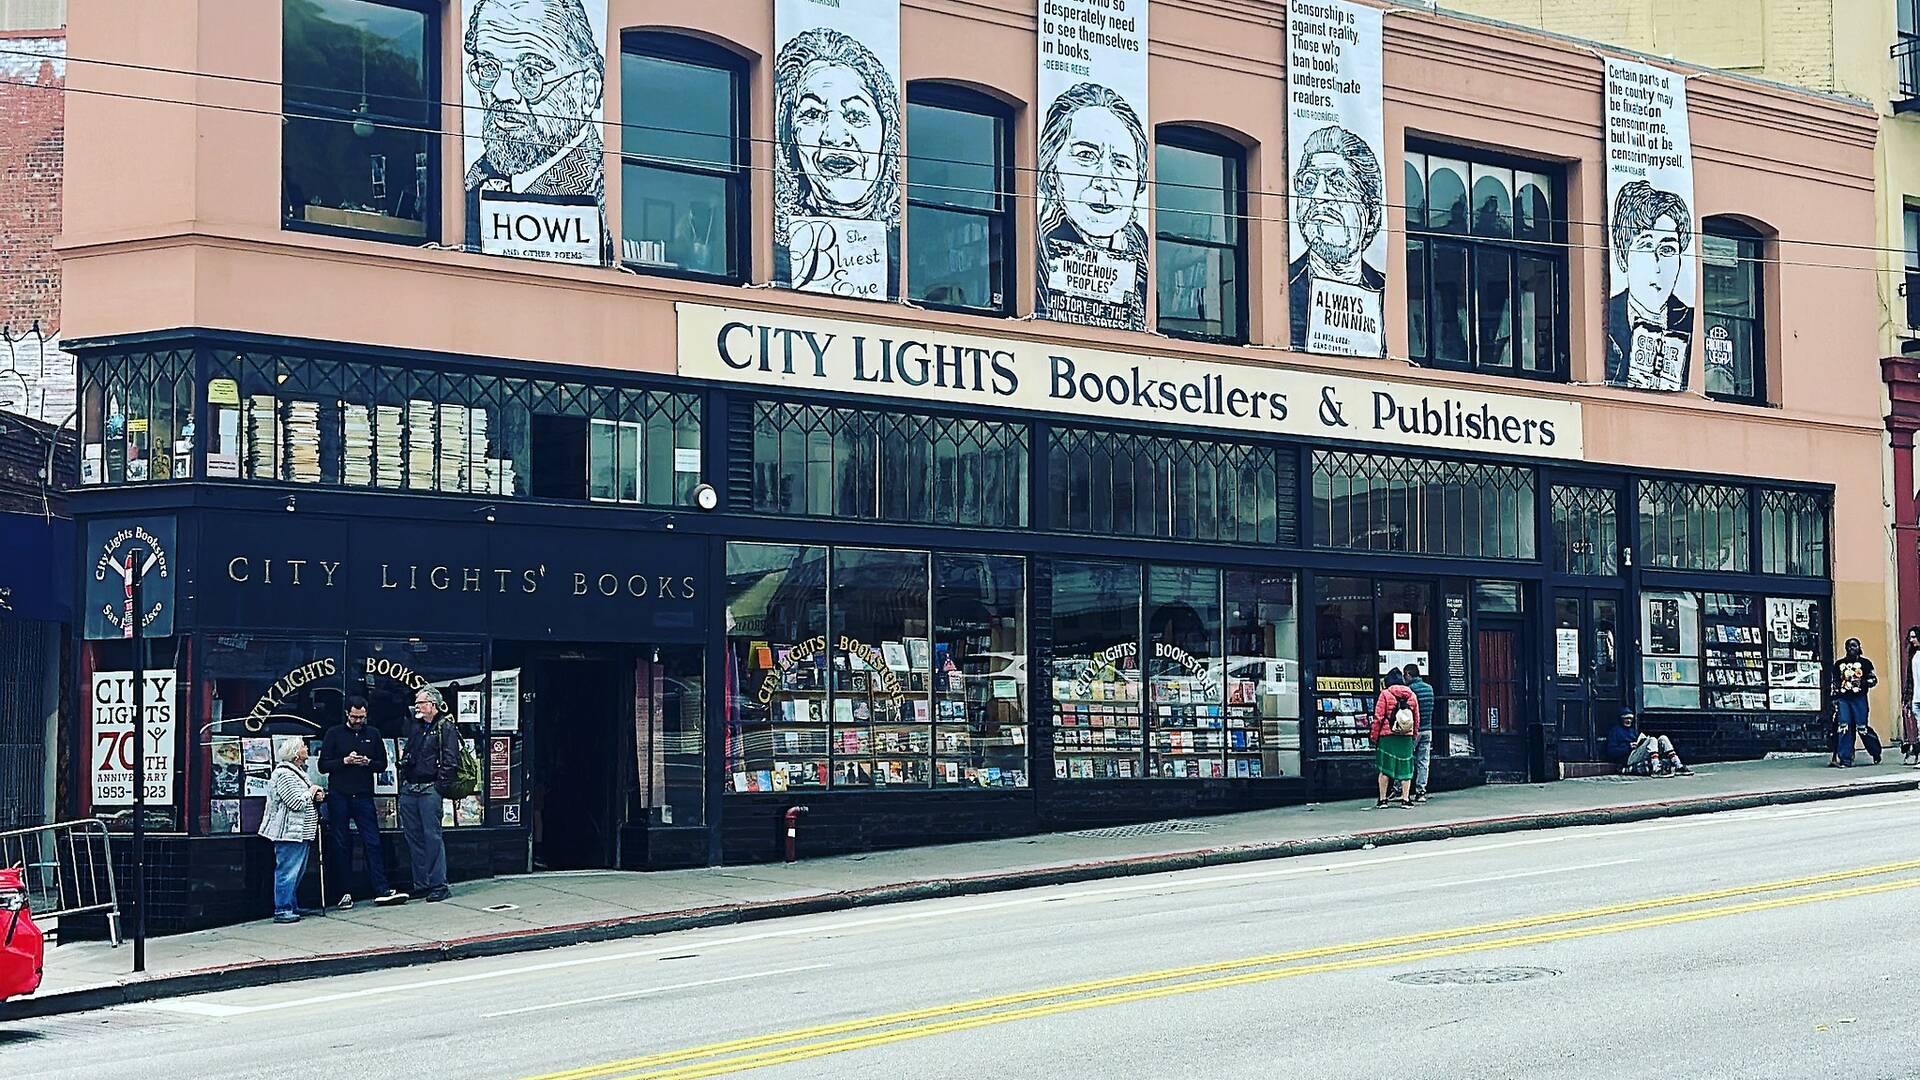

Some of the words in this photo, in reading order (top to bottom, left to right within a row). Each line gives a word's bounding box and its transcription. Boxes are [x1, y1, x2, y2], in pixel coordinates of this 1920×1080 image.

[1044, 2, 1106, 30] desperately
[1109, 16, 1135, 32] need
[1291, 0, 1344, 25] Censorship
[1346, 12, 1355, 24] is
[1043, 18, 1054, 34] to
[1057, 24, 1076, 38] see
[1079, 25, 1139, 52] themselves
[1292, 20, 1326, 36] against
[1043, 40, 1053, 53] in
[1058, 39, 1092, 61] books.
[1292, 34, 1319, 53] Those
[1293, 52, 1310, 68] ban
[1609, 64, 1637, 81] Certain
[1293, 91, 1334, 108] readers.
[1609, 81, 1623, 95] the
[1657, 92, 1674, 109] may
[1610, 97, 1621, 111] be
[1648, 107, 1662, 117] on
[1611, 129, 1626, 144] but
[1662, 136, 1673, 150] be
[1649, 123, 1669, 135] me.
[493, 213, 590, 243] HOWL
[846, 229, 867, 243] The
[555, 251, 583, 260] POEMS
[1085, 250, 1098, 263] AN
[1063, 260, 1118, 281] INDIGENOUS
[1067, 275, 1114, 294] PEOPLES'
[1050, 294, 1087, 313] HISTORY
[1092, 302, 1104, 316] OF
[1110, 306, 1129, 320] THE
[1316, 290, 1363, 314] ALWAYS
[1051, 308, 1086, 324] UNITED
[1325, 309, 1376, 334] RUNNING
[717, 321, 836, 378] CITY
[853, 336, 1019, 396] LIGHTS
[1048, 356, 1288, 421] Booksellers
[1318, 386, 1349, 428] &
[1373, 390, 1556, 447] Publishers
[104, 529, 133, 554] Lights
[136, 526, 167, 577] Bookstore
[228, 557, 340, 586] CITY
[574, 572, 695, 598] BOOKS
[103, 604, 119, 626] San
[1155, 642, 1217, 699] BOOKSTORE
[245, 687, 279, 732] CITY
[274, 658, 336, 697] LIGHTS
[1329, 680, 1361, 690] LIGHTS
